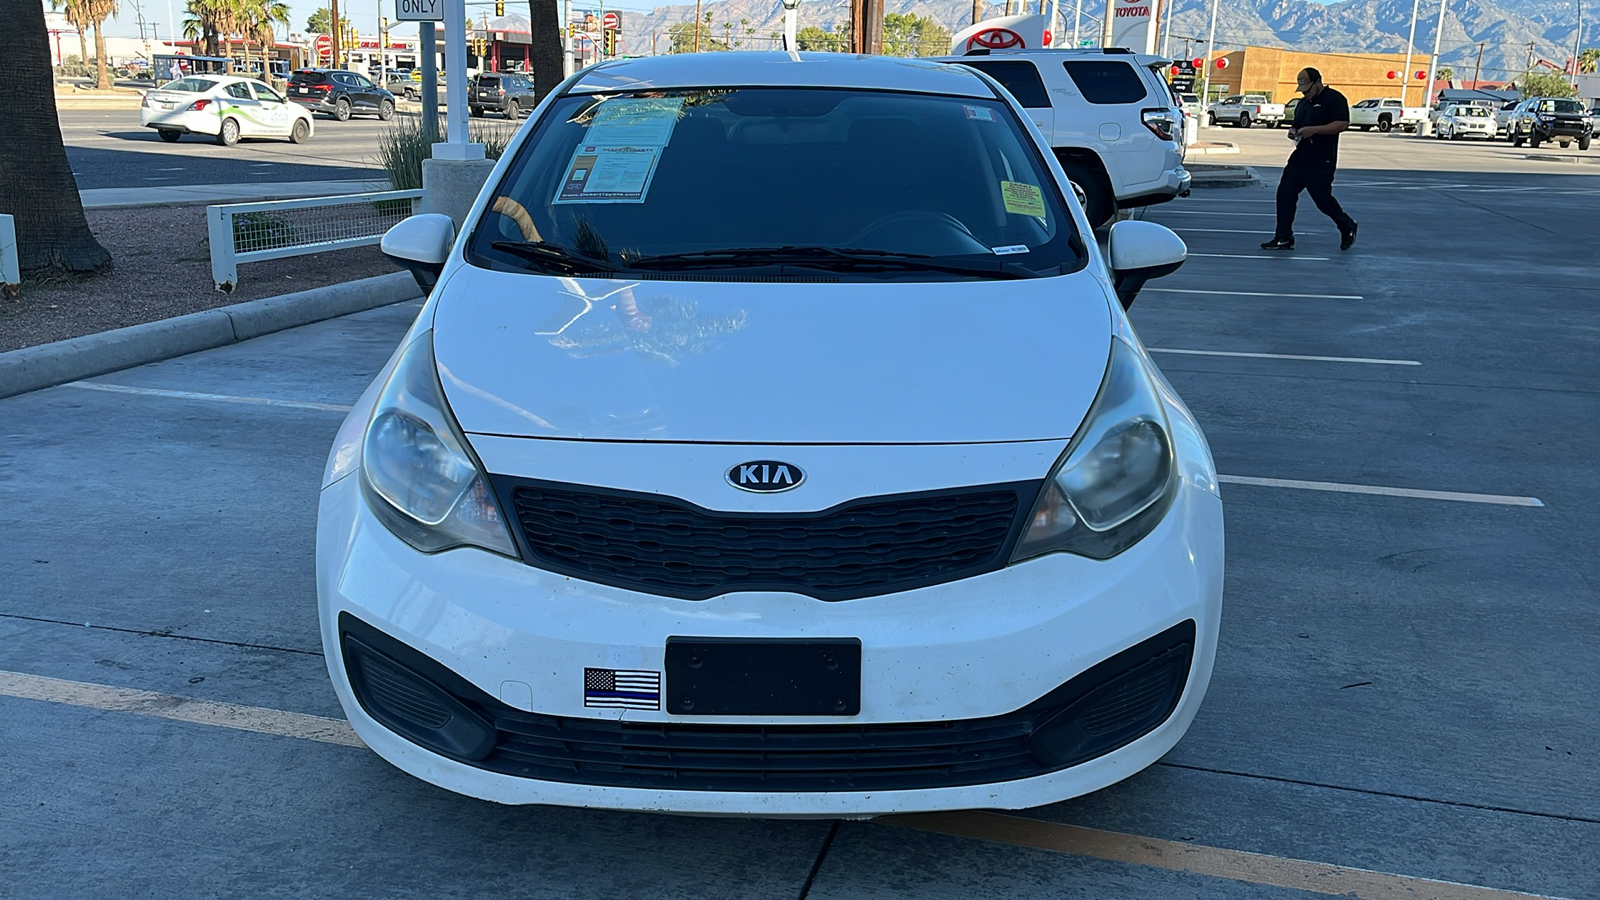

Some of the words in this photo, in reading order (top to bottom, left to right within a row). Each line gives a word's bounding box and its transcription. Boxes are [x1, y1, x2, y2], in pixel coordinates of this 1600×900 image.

[402, 0, 436, 13] ONLY
[1114, 6, 1150, 17] TOYOTA
[739, 464, 794, 484] KIA
